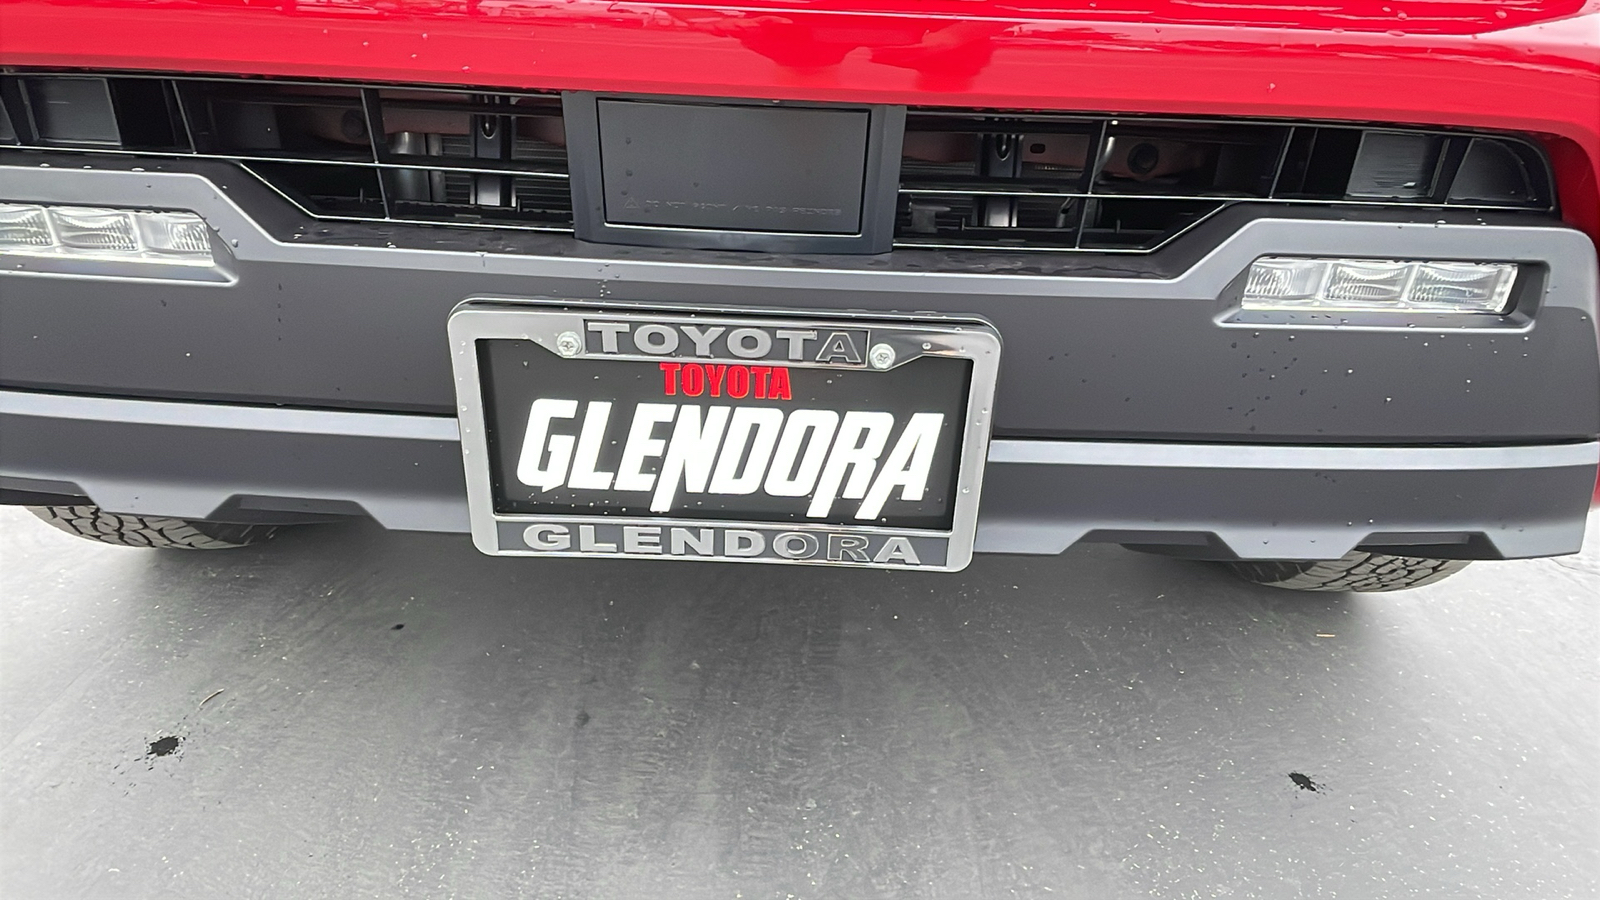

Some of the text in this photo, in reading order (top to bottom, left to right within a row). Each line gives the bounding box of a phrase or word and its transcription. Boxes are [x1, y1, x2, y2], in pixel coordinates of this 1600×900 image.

[587, 321, 862, 363] TOYOTA
[659, 362, 792, 400] TOYOTA
[516, 398, 945, 520] GLENDORA
[523, 524, 921, 564] GLENDORA
